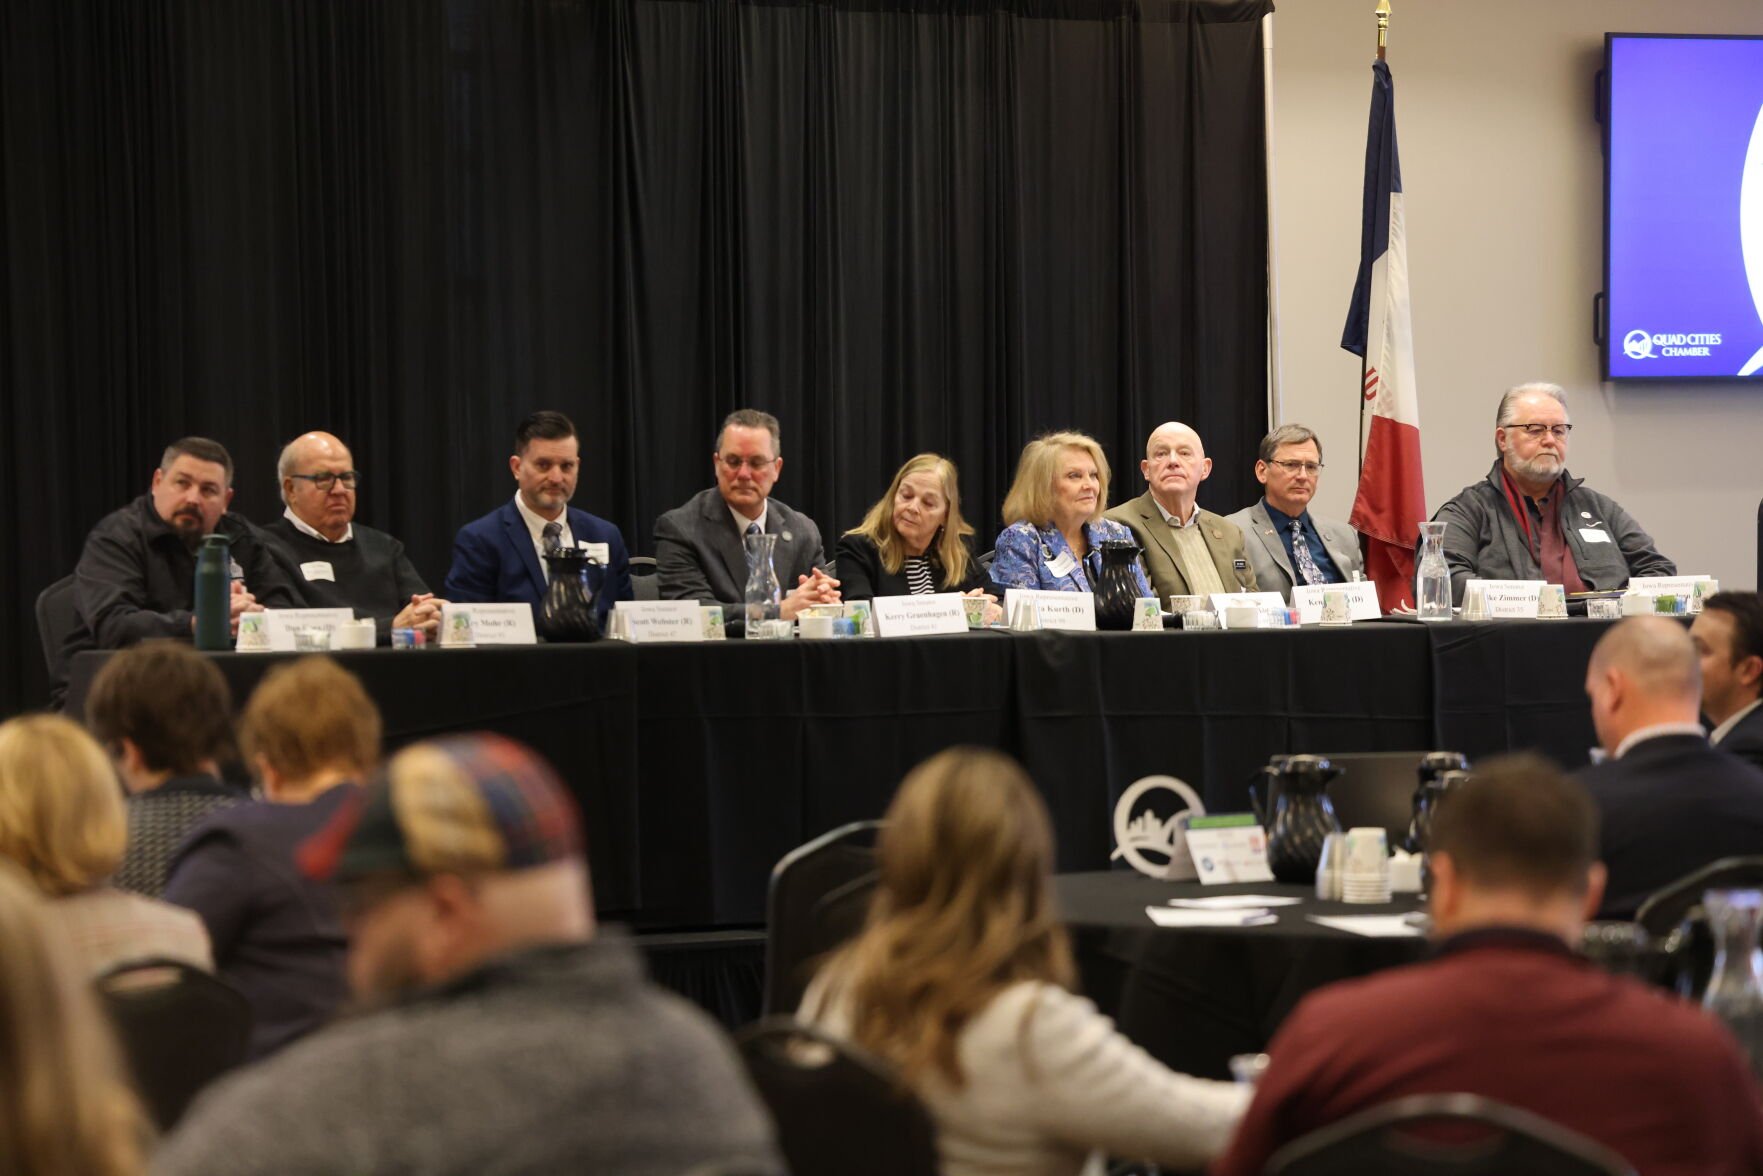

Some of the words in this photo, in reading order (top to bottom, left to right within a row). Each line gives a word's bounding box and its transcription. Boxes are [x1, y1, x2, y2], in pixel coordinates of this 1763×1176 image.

[1652, 333, 1686, 346] QUAD
[1687, 333, 1722, 345] CITIES
[1661, 346, 1711, 357] CHAMBER
[1351, 595, 1364, 604] (D)
[884, 613, 905, 621] Kerry
[906, 609, 948, 620] Gruenhagen
[948, 609, 960, 618] (R)
[1047, 605, 1070, 613] Kurth
[1071, 606, 1084, 615] (D)
[651, 617, 679, 625] Webster
